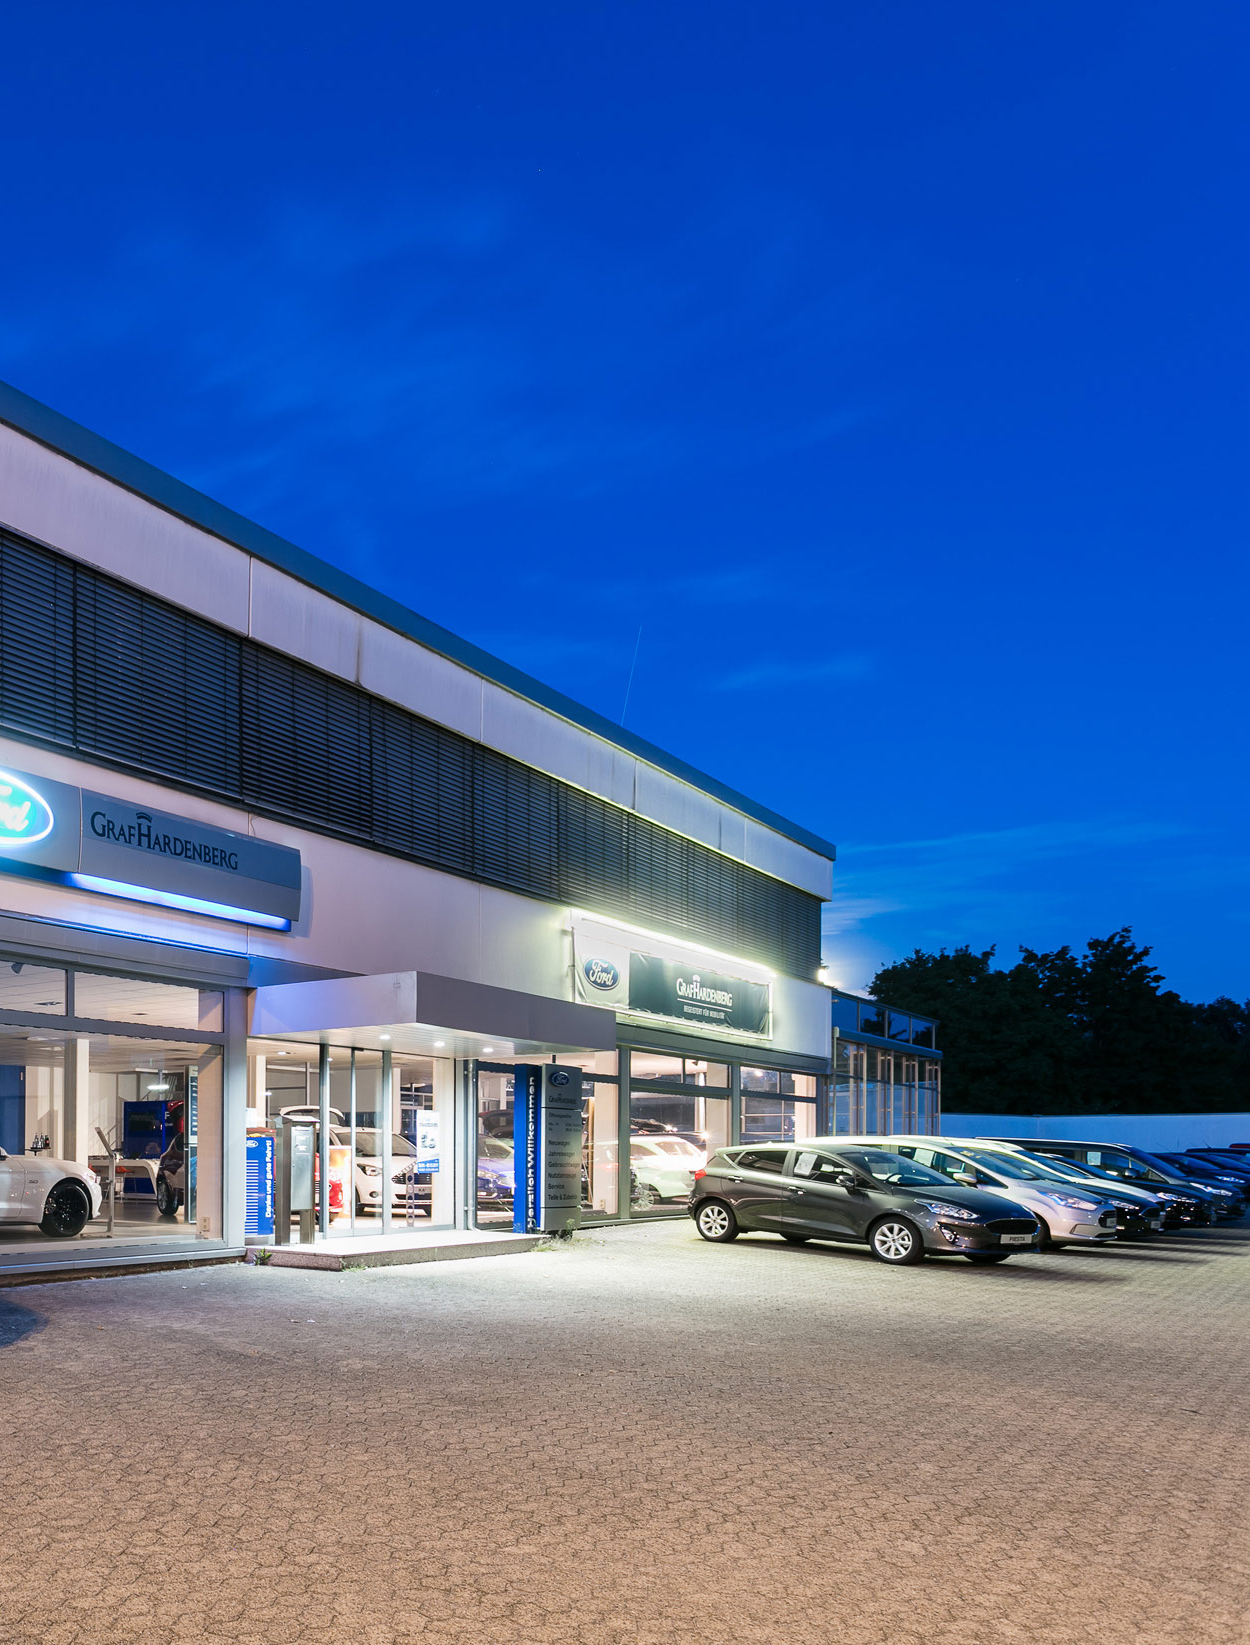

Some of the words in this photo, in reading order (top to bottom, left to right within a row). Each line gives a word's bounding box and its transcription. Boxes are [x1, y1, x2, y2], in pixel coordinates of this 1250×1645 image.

[589, 959, 614, 985] Ford
[527, 1076, 535, 1168] Willkommen
[265, 1162, 273, 1179] gute
